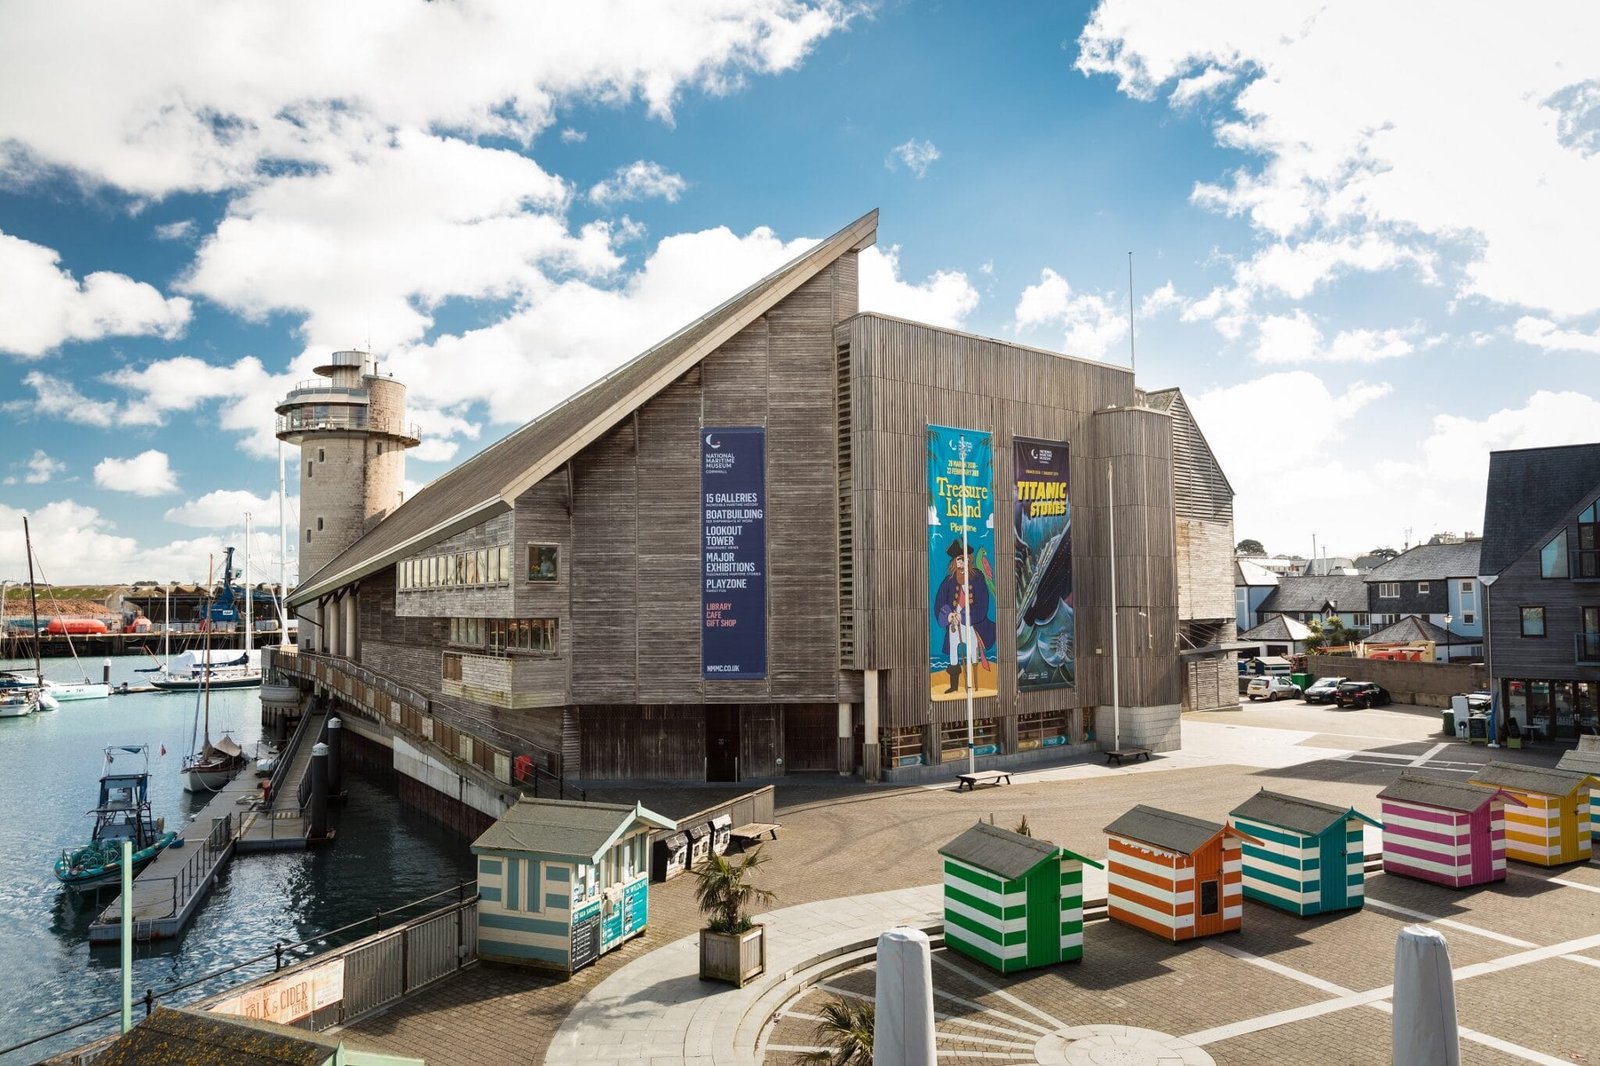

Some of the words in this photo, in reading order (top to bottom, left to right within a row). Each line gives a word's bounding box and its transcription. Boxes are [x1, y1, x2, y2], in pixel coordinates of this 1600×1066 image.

[1018, 481, 1067, 501] TITANIC
[706, 493, 714, 503] 15
[715, 493, 758, 502] GALLERIES
[946, 497, 981, 518] Islnd
[1030, 502, 1066, 517] STORIES
[706, 509, 763, 519] BOATBUILDING
[706, 526, 743, 535] LOOKOUT
[950, 522, 977, 534] Playone
[706, 536, 734, 545] TOWER
[706, 553, 735, 561] MAJOR
[706, 562, 755, 572] EXHIBITIONS
[706, 579, 747, 588] PLAYZONE
[280, 982, 308, 1010] CIDER
